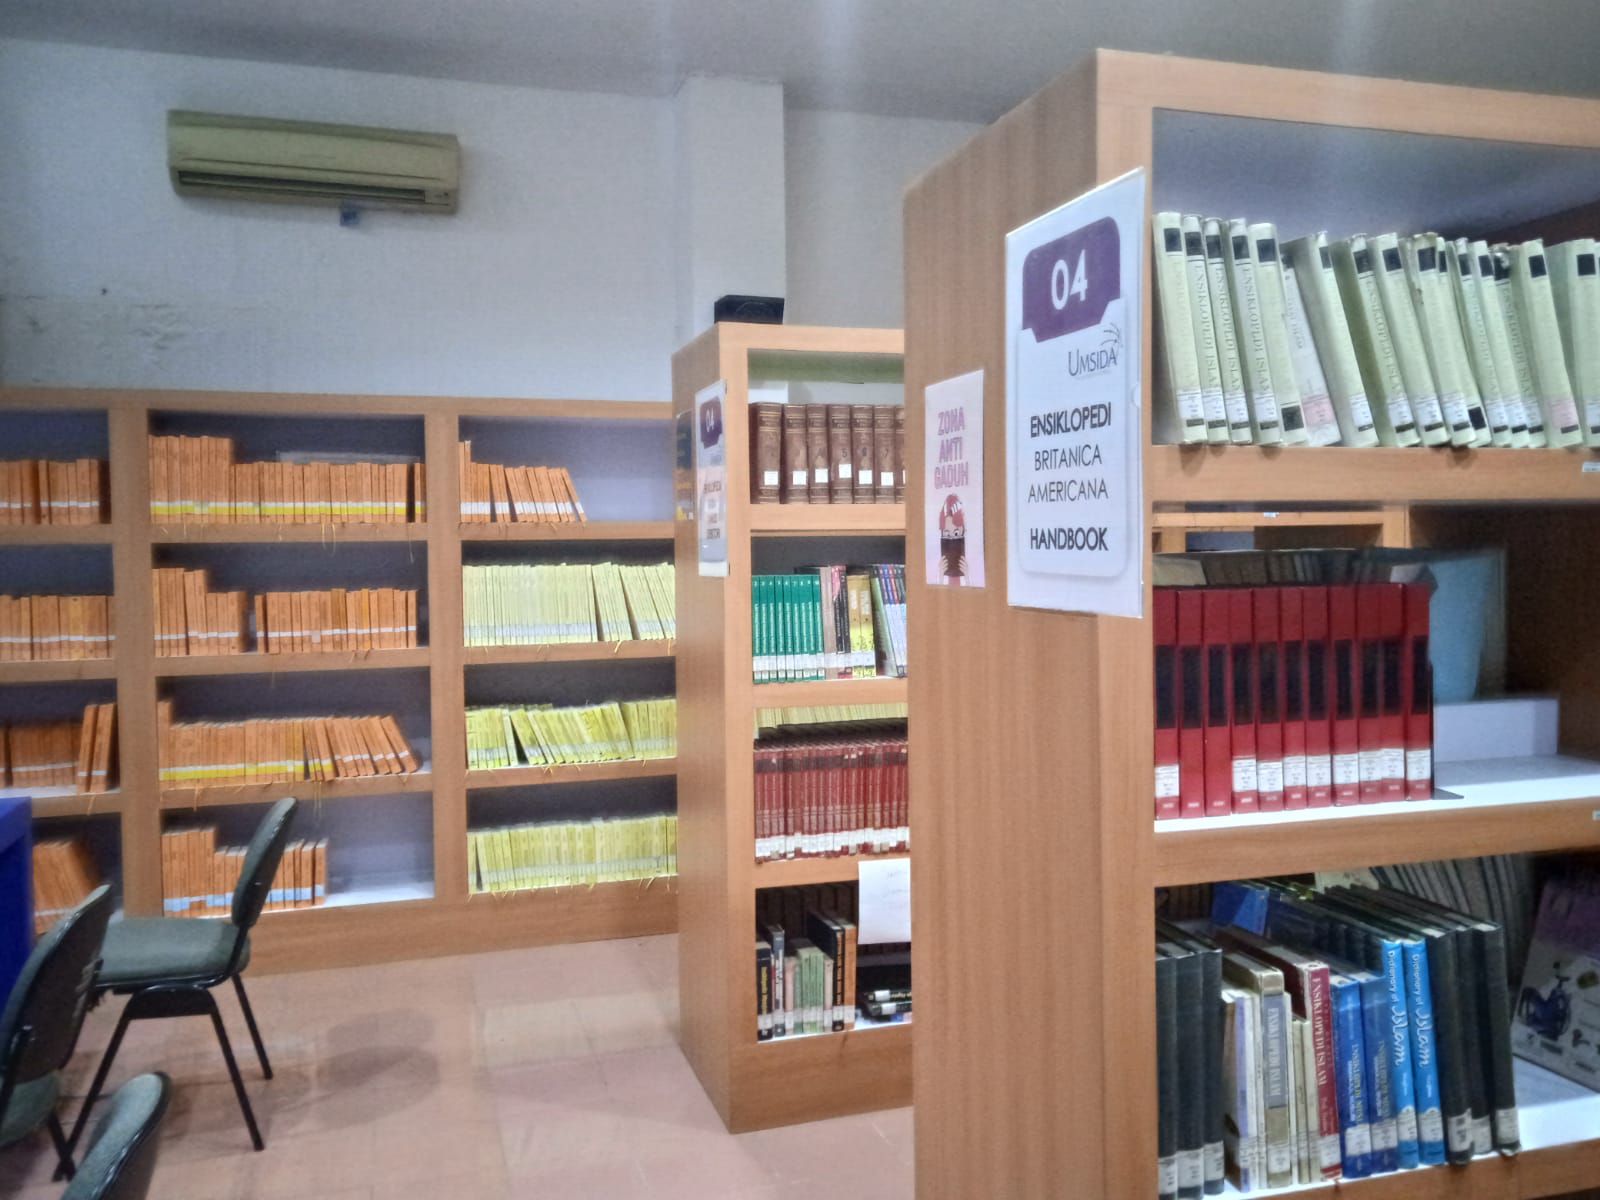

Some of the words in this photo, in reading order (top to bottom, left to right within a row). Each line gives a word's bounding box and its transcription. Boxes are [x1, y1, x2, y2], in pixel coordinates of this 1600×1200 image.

[1051, 248, 1088, 310] 04
[1194, 264, 1214, 350] ENSIKLOPEDI
[1204, 354, 1222, 388] ISLA
[1216, 267, 1237, 351] ENSIKLOPEDI
[1242, 268, 1264, 352] ENSIKLOPEDI
[705, 407, 715, 433] 04
[937, 406, 966, 436] ZONA
[1030, 402, 1112, 438] ENSIKLOPEDI
[938, 436, 963, 463] ANTI
[1034, 443, 1103, 472] BRITANICA
[934, 461, 969, 489] GADUH
[1027, 477, 1109, 504] AMERICANA
[1030, 527, 1109, 551] HANDBOOK
[1412, 953, 1422, 996] Dictionary
[1312, 977, 1326, 1050] ENSIKLOPEDI
[1387, 950, 1397, 993] Dictionary
[1392, 1004, 1409, 1066] Islam
[1416, 1006, 1433, 1068] Islam
[1269, 1068, 1282, 1097] ISLAM
[1316, 1051, 1329, 1086] ISLAM
